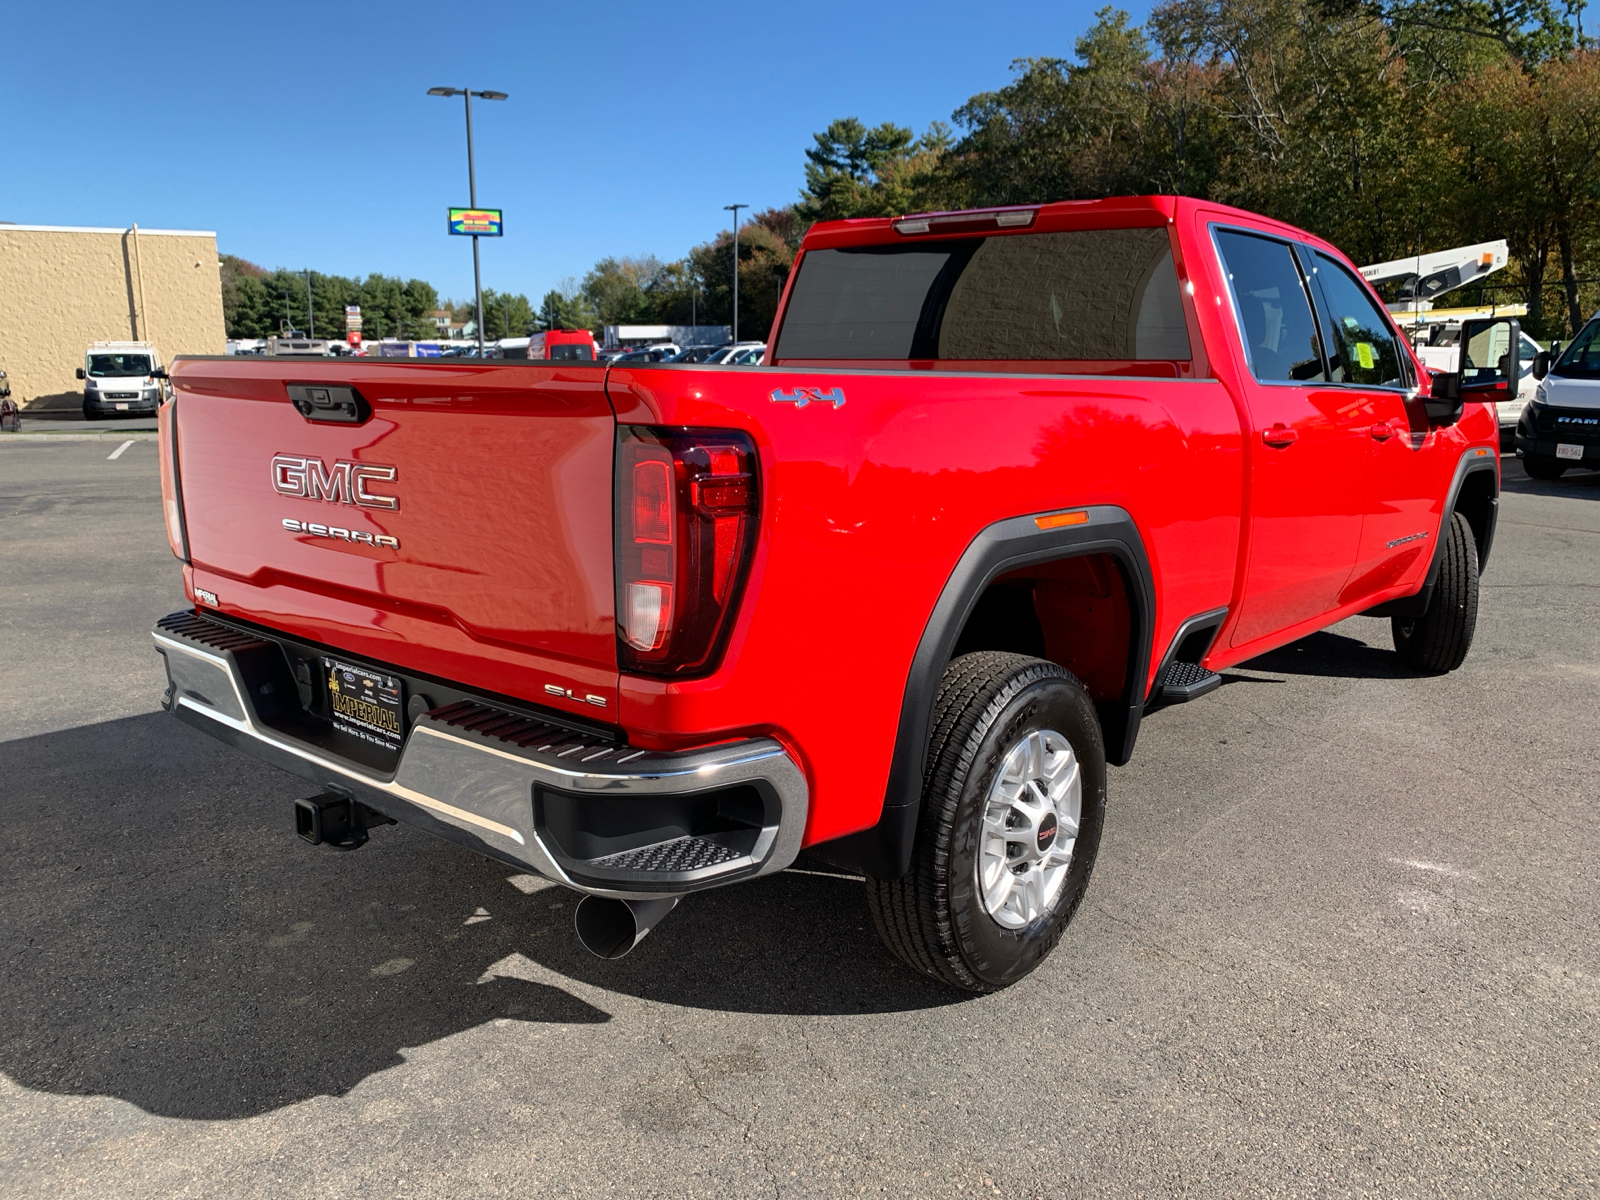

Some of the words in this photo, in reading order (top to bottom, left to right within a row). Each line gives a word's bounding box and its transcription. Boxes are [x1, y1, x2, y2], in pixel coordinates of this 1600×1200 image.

[1557, 417, 1598, 425] RAM
[271, 455, 399, 511] GMC
[282, 518, 401, 550] SIERRA
[544, 684, 607, 708] SLE
[332, 691, 400, 733] IMPERIAL
[333, 711, 401, 740] www.imperialcars.com
